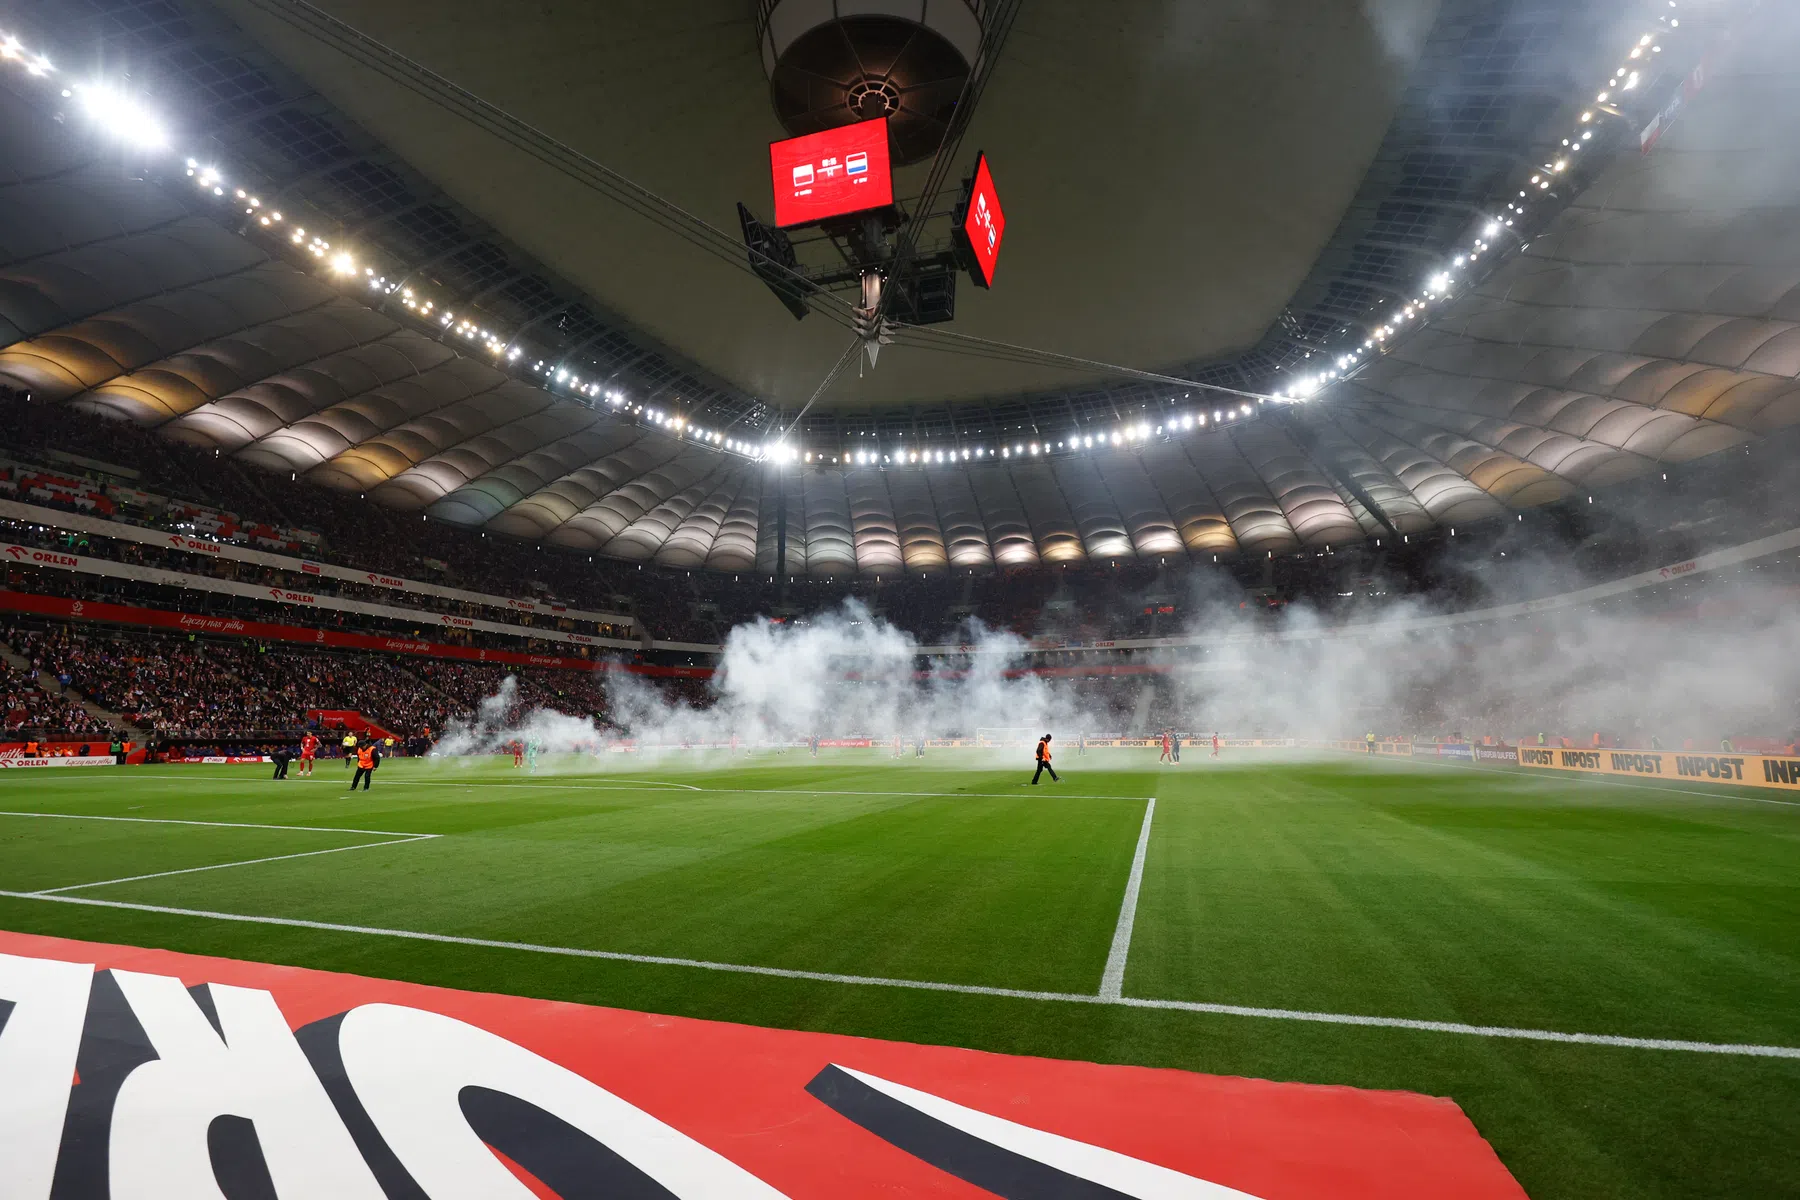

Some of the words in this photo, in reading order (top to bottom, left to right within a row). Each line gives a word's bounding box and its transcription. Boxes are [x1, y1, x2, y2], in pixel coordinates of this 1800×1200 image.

[188, 540, 221, 553] ORLEN
[33, 552, 78, 567] ORLEN
[1671, 562, 1696, 575] ORLEN
[379, 577, 403, 587] ORLEN
[286, 592, 314, 603] ORLEN
[517, 601, 535, 610] ORLEN
[180, 615, 206, 629] Łączy
[207, 620, 222, 628] nas
[452, 618, 473, 627] ORLEN
[575, 635, 592, 643] ORLEN
[1521, 749, 1554, 766] INPOST
[1561, 751, 1601, 769] INPOST
[1611, 753, 1662, 774] INPOST
[1676, 756, 1744, 781] INPOST
